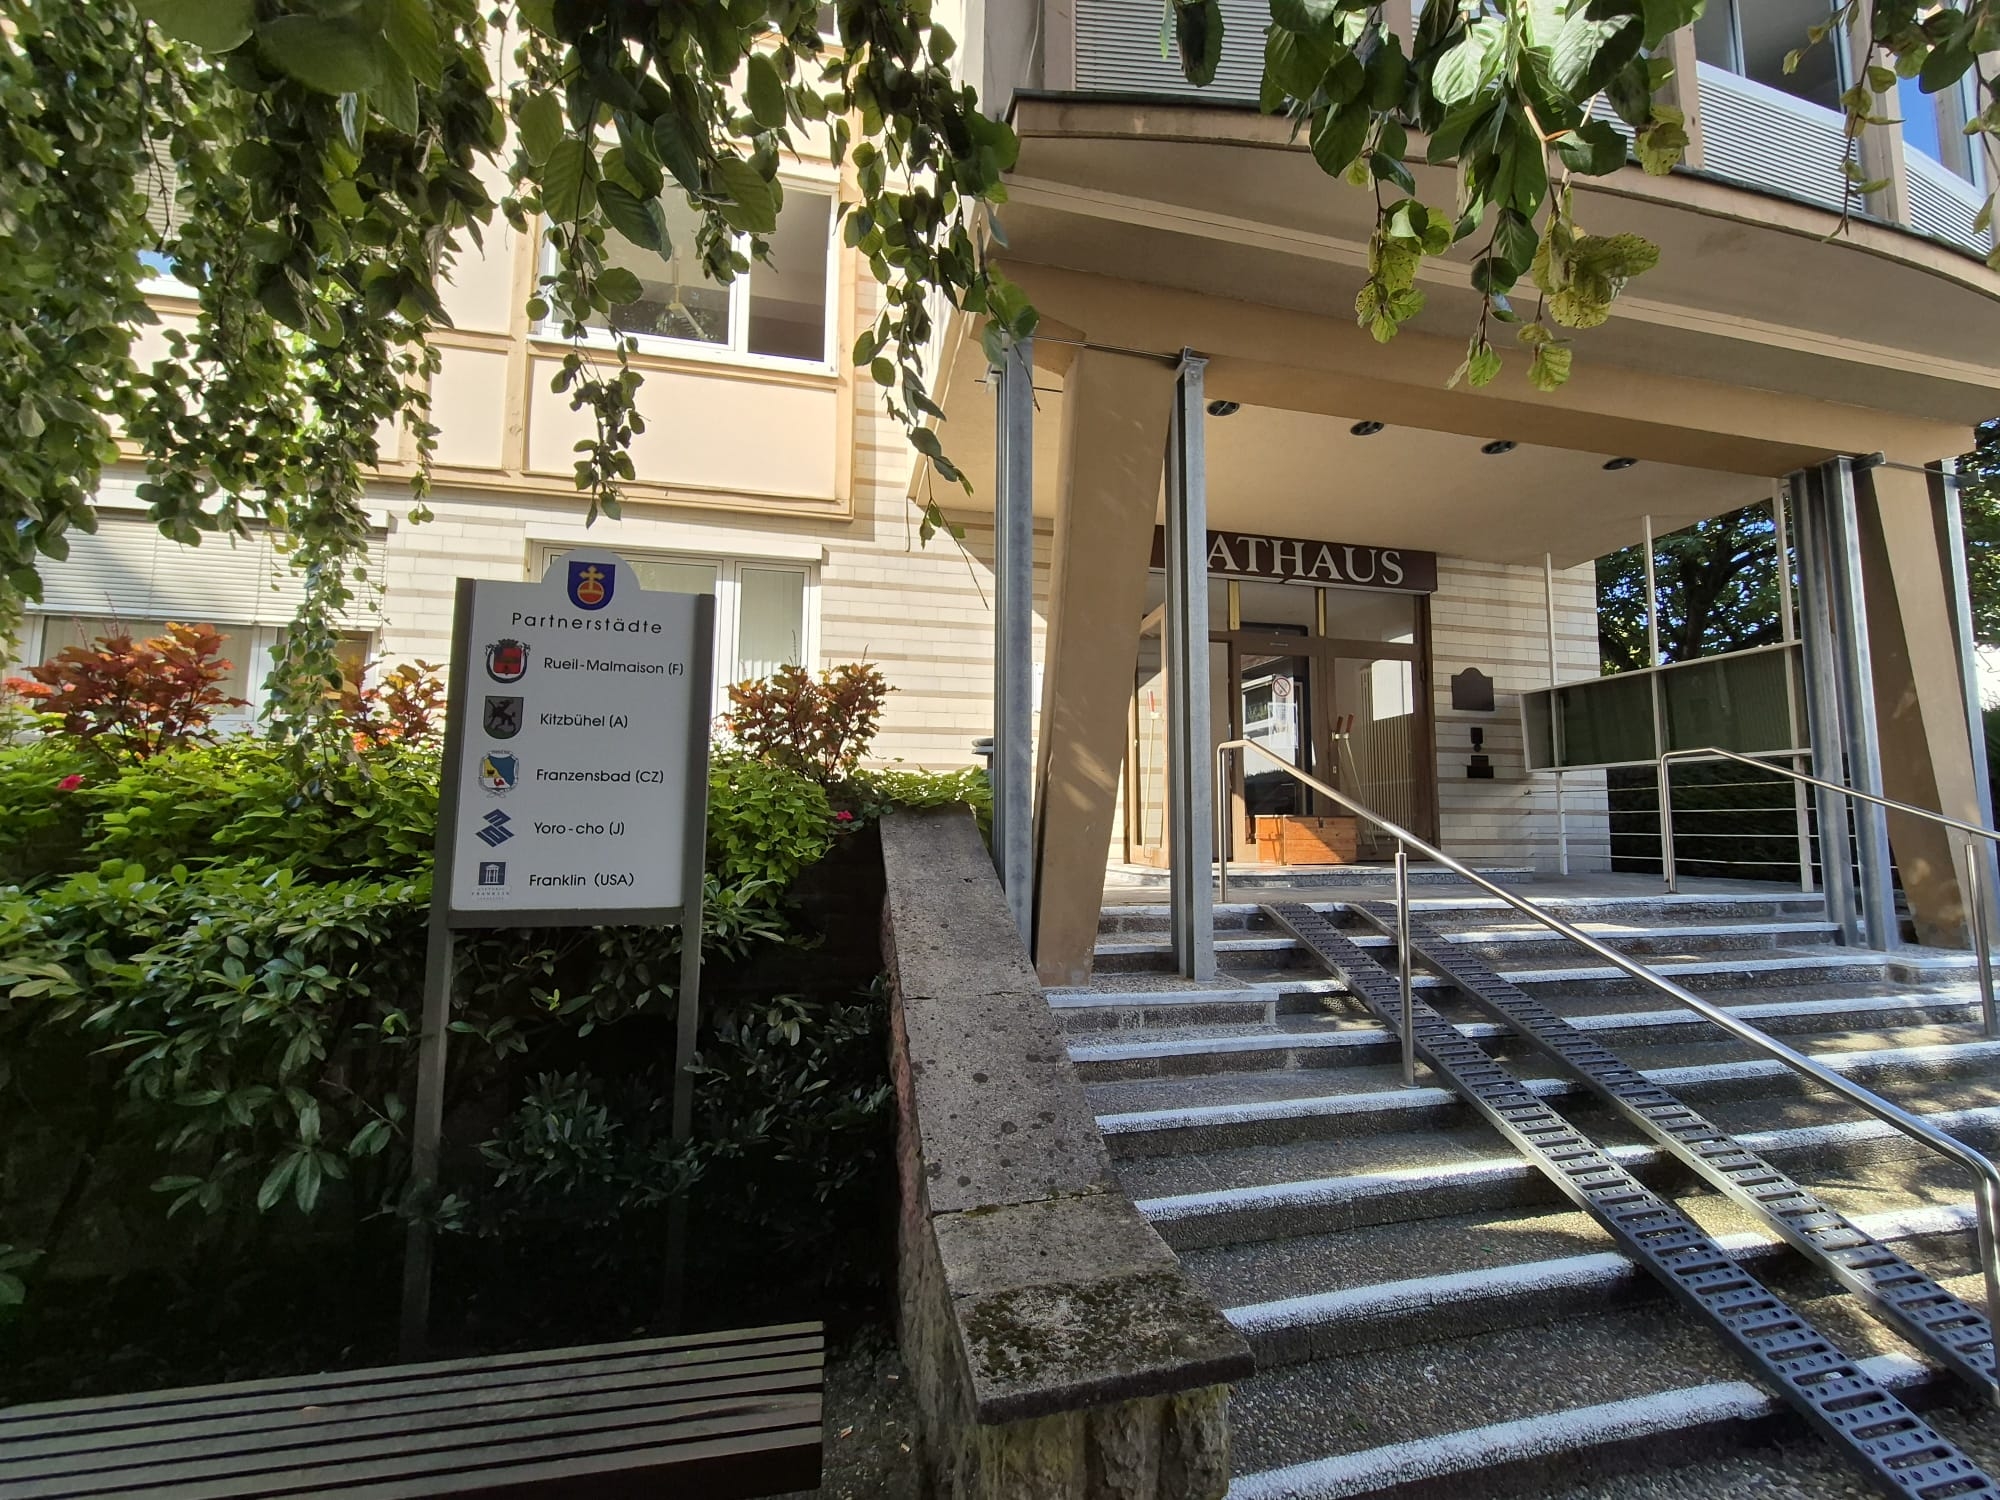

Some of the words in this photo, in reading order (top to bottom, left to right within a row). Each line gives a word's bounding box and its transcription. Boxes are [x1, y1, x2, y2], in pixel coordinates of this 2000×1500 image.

[1207, 534, 1404, 585] ATHAUS
[511, 612, 662, 634] Partnerstädte
[543, 657, 664, 674] Rueil-Malmaison
[668, 661, 684, 677] (F)
[540, 713, 605, 727] Kitzbühel
[609, 714, 628, 728] (A)
[536, 768, 630, 782] Franzensbad
[635, 770, 664, 784] (CZ)
[609, 821, 625, 836] (J)
[529, 874, 586, 886] Franklin
[593, 872, 635, 887] (USA)
